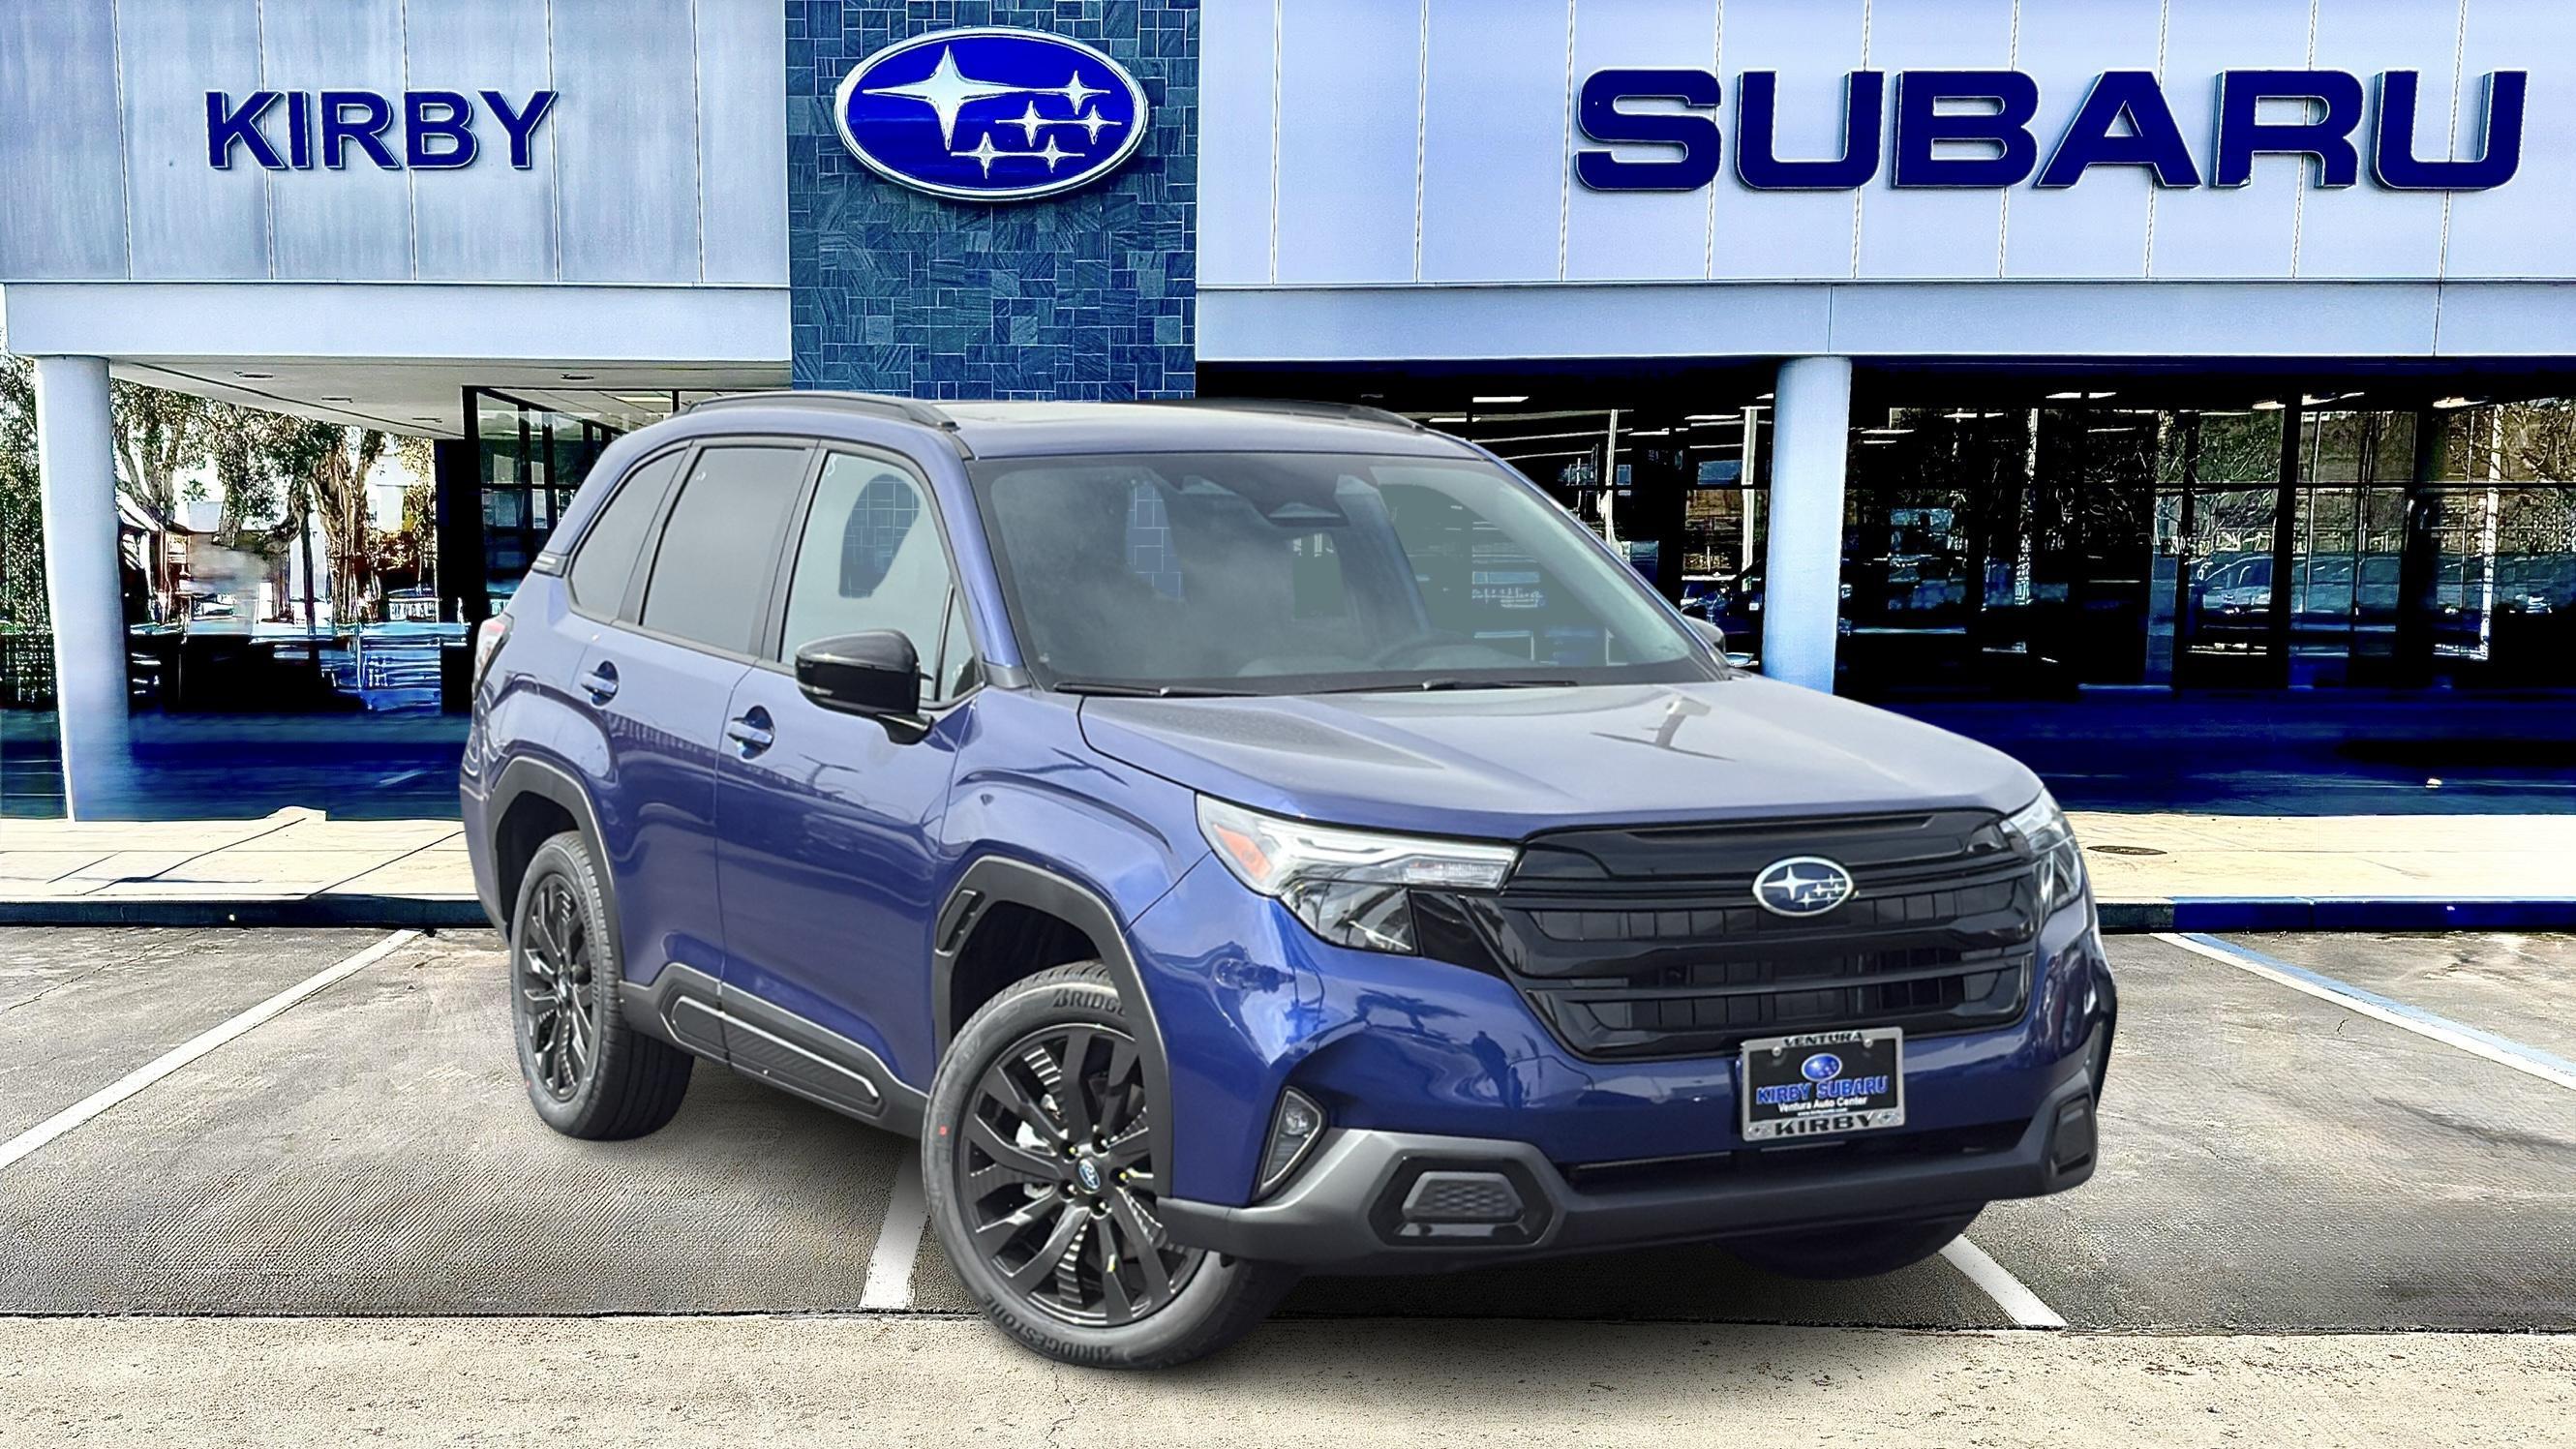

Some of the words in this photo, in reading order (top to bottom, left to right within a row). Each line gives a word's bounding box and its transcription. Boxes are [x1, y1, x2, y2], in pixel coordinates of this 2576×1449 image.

[204, 90, 559, 170] KIRBY
[1574, 69, 2528, 191] SUBARU
[1784, 1032, 1863, 1046] VENTURA
[1757, 1083, 1811, 1104] KIRBY
[1816, 1076, 1888, 1098] SUBARU
[1777, 1102, 1813, 1113] Ventura
[1813, 1099, 1836, 1109] Auto
[1836, 1096, 1868, 1107] Center
[1774, 1113, 1875, 1135] KIRBY
[982, 1292, 1113, 1362] BRIDGESTONE
